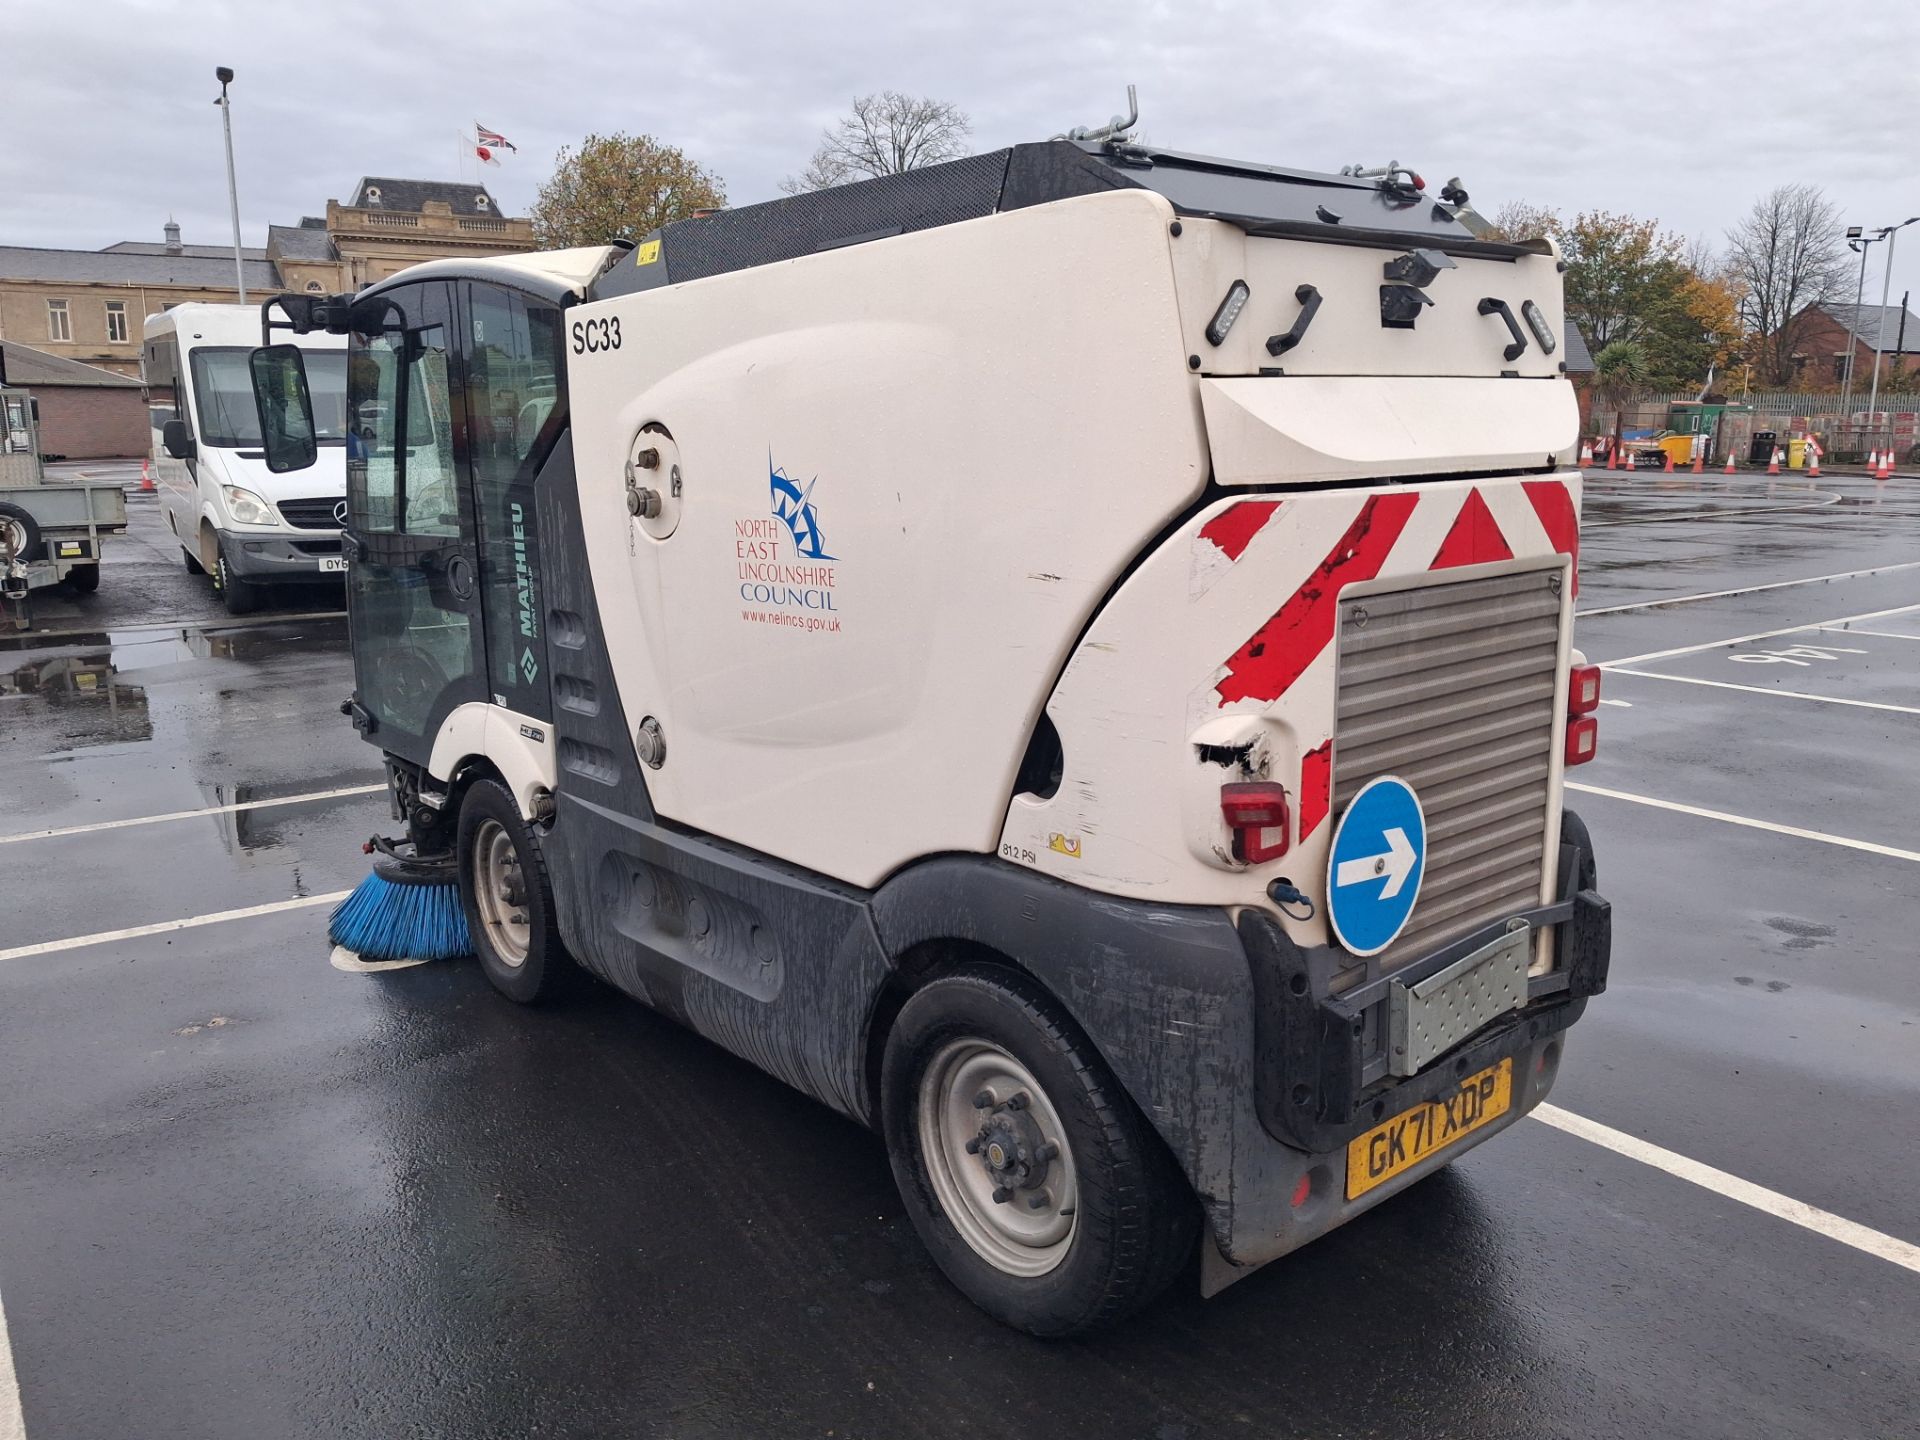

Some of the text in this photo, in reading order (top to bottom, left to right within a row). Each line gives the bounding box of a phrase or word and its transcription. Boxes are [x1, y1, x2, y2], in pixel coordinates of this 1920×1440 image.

[573, 316, 621, 355] SC33
[735, 519, 778, 539] NORTH
[736, 540, 780, 560] EAST
[511, 502, 533, 638] MATHIEU
[738, 561, 836, 588] LINCOLNSHIRE
[740, 582, 839, 611] COUNCIL
[742, 610, 842, 632] www.nelincs.gov.uk
[1022, 848, 1036, 865] PSI
[1368, 1104, 1435, 1179] GK71
[1441, 1074, 1496, 1139] XDP
